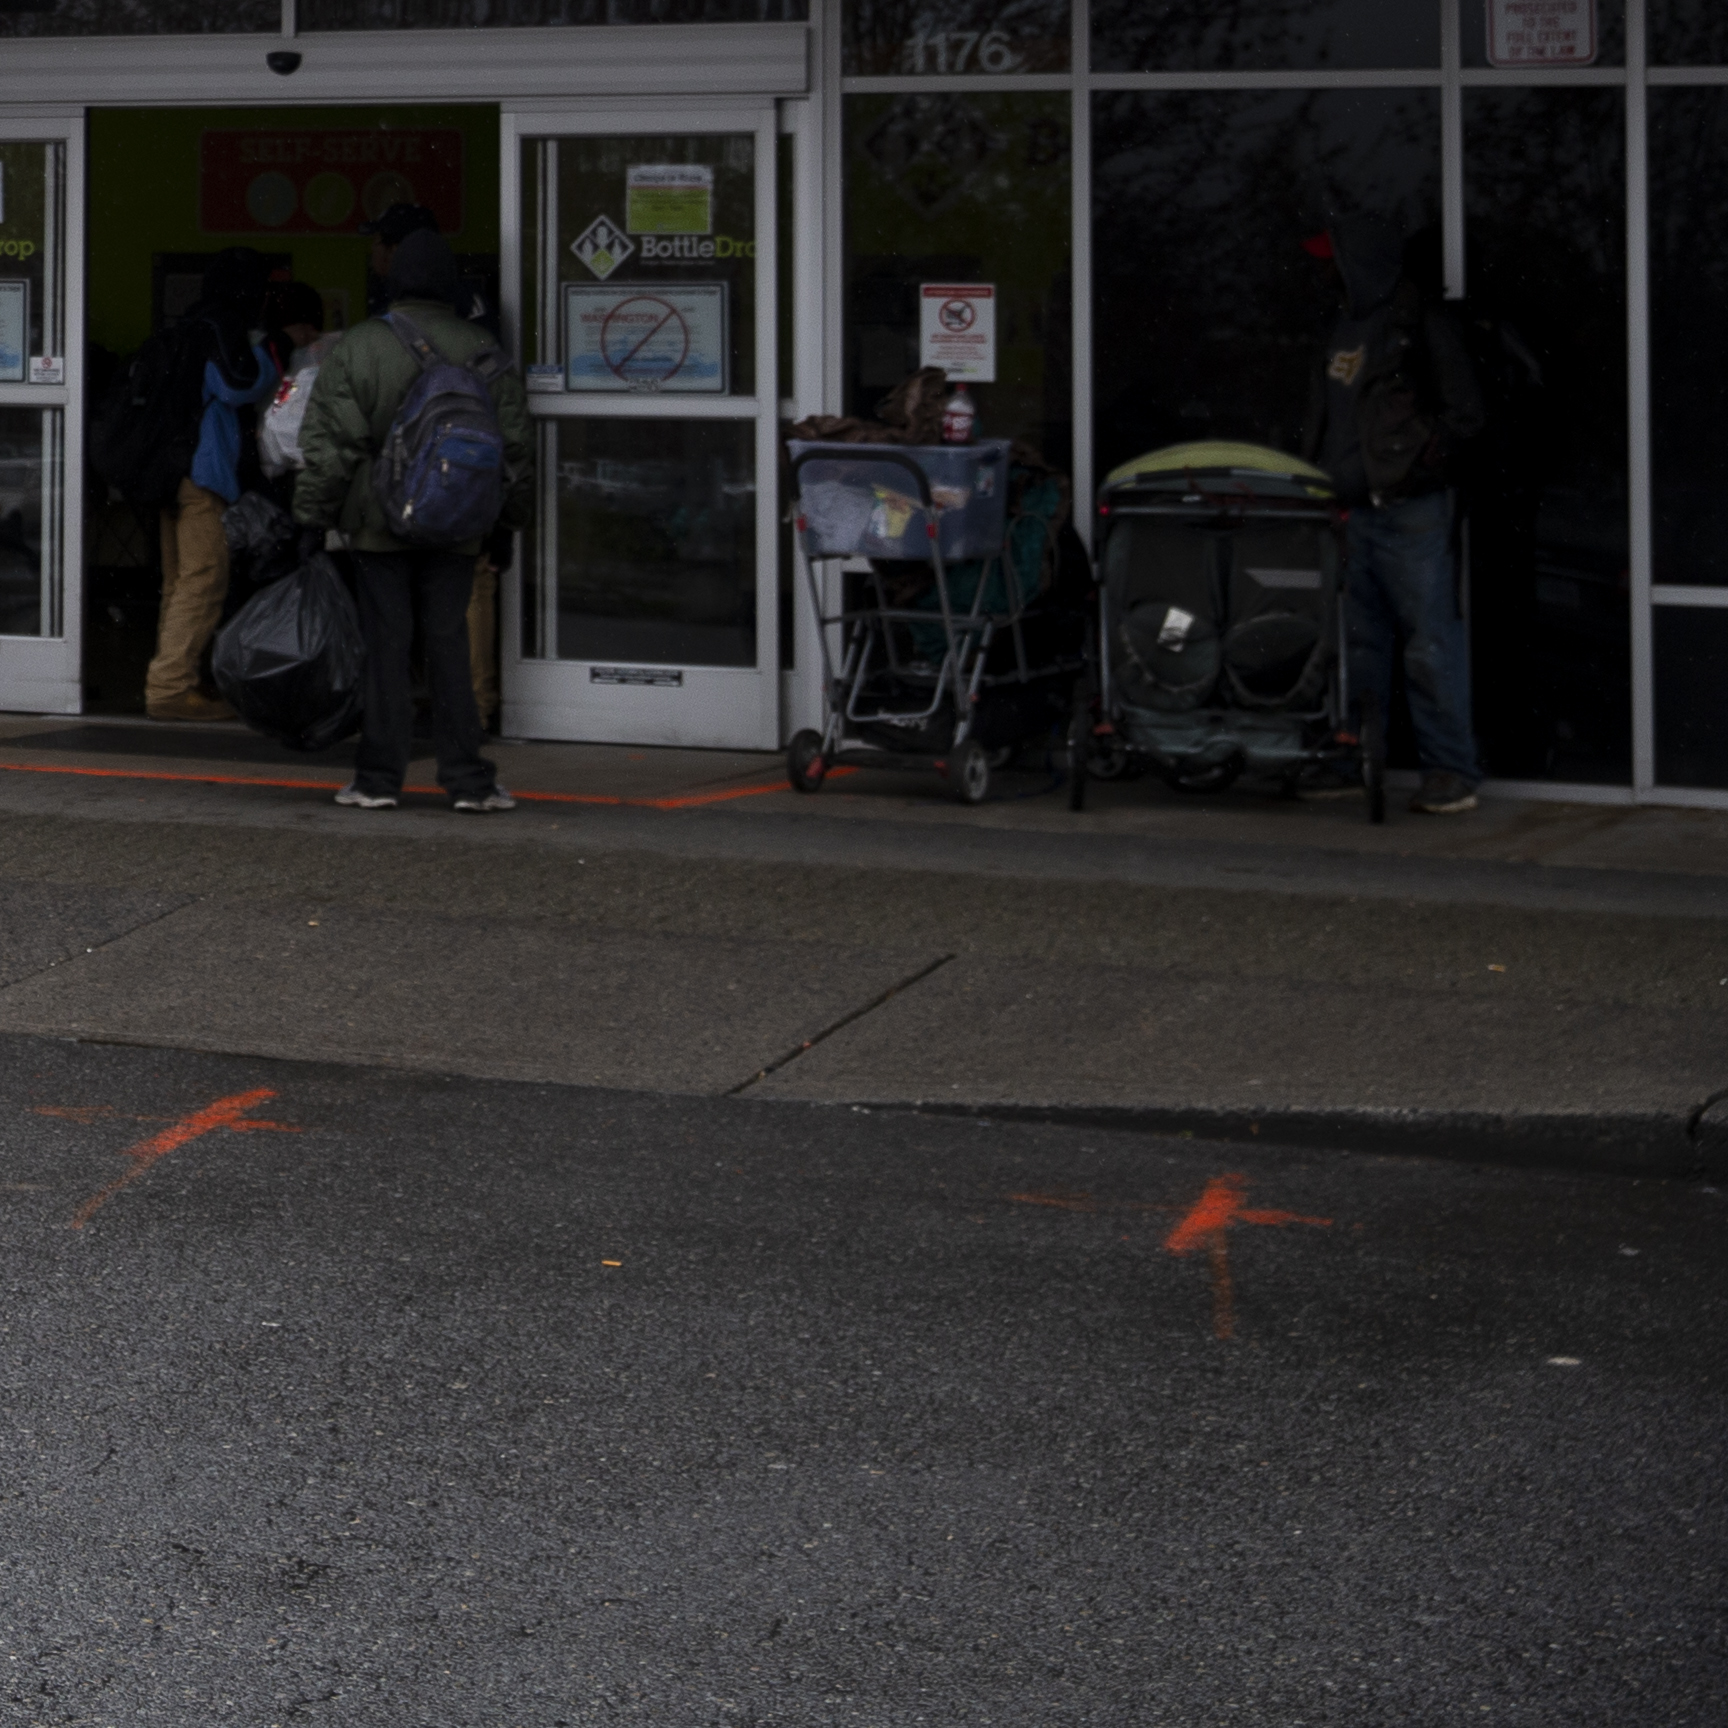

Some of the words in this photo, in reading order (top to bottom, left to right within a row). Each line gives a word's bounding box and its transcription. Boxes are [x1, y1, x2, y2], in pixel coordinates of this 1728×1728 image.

[904, 30, 1012, 74] 1176
[239, 136, 422, 164] SELF-SERVE
[640, 235, 756, 259] BottleDro
